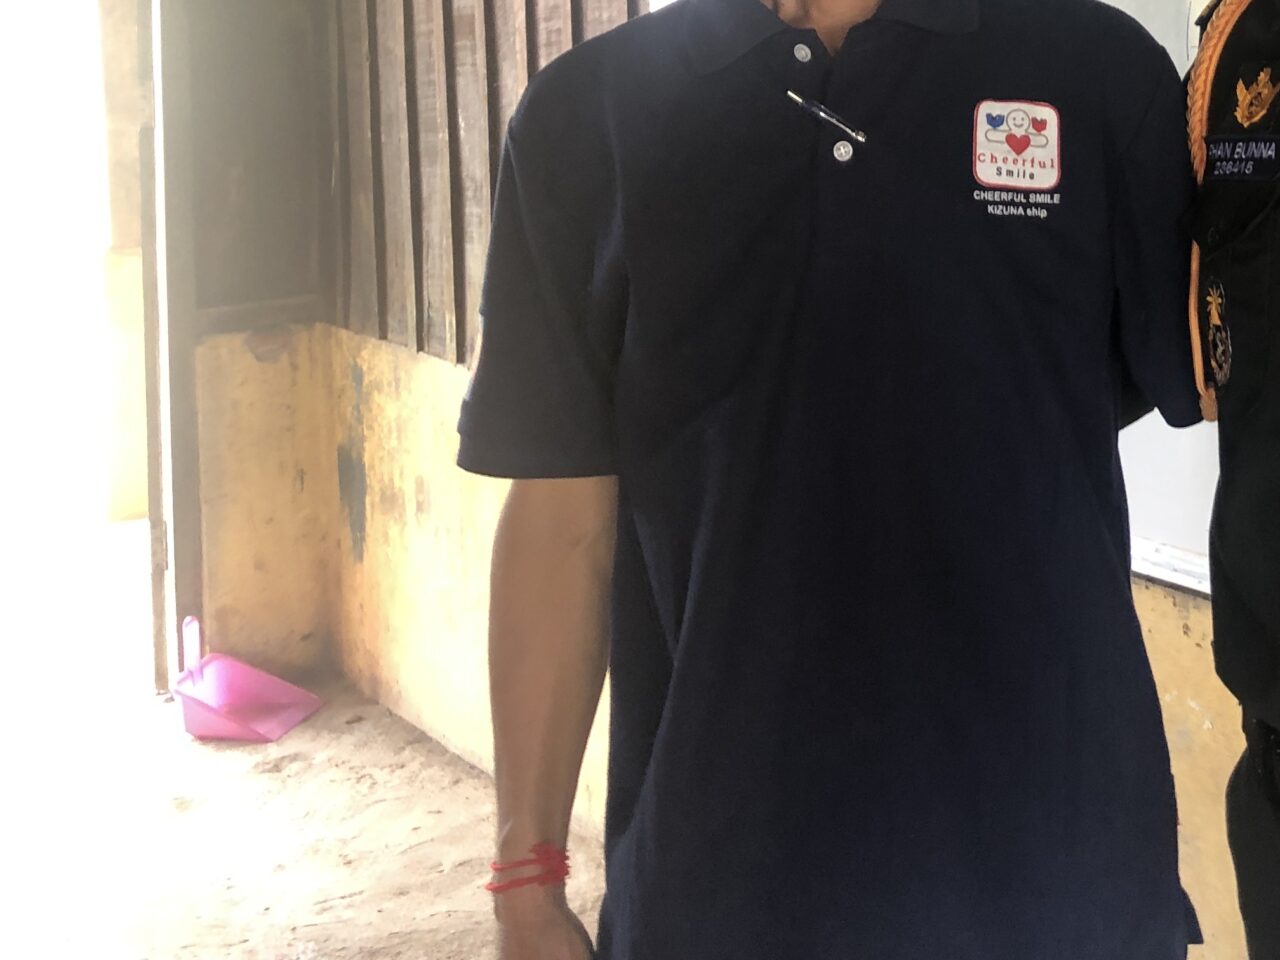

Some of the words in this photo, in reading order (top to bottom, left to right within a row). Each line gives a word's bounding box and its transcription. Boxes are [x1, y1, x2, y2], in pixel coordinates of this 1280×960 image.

[1234, 141, 1277, 159] BUNNA
[977, 152, 1056, 170] Cheerful
[995, 166, 1036, 181] Smile
[973, 190, 1027, 204] CHEERFUL
[1028, 192, 1061, 205] SMILE
[987, 204, 1025, 217] KIZUNA
[1026, 206, 1048, 219] ship
